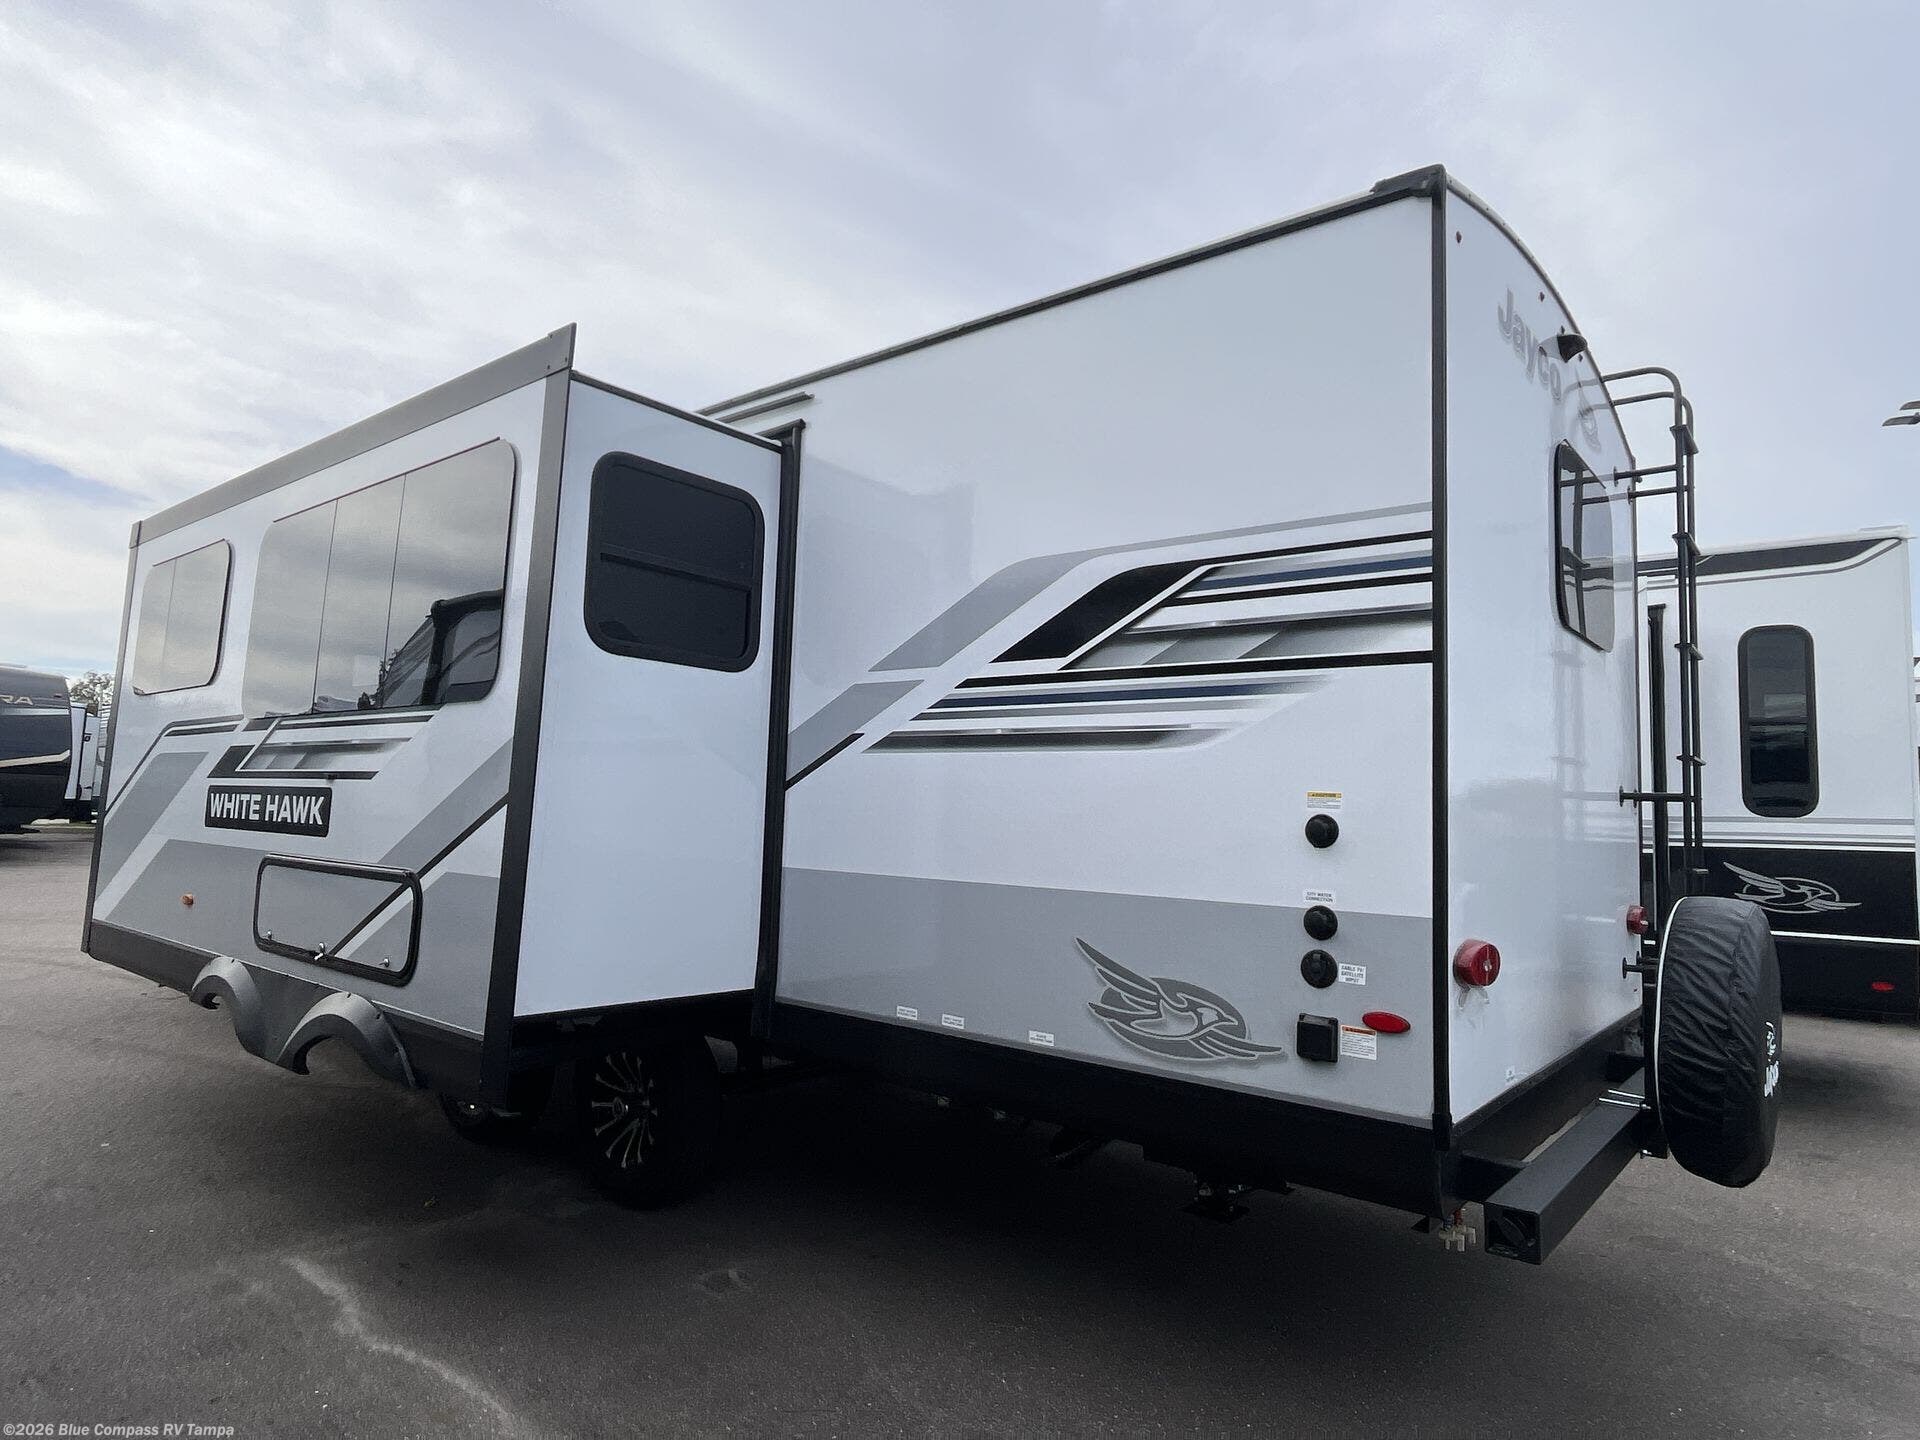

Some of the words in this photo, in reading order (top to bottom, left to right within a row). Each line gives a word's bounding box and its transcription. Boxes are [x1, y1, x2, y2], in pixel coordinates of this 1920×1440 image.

[1498, 286, 1562, 401] Jayco
[210, 792, 262, 821] WHITE
[264, 794, 325, 825] HAWK
